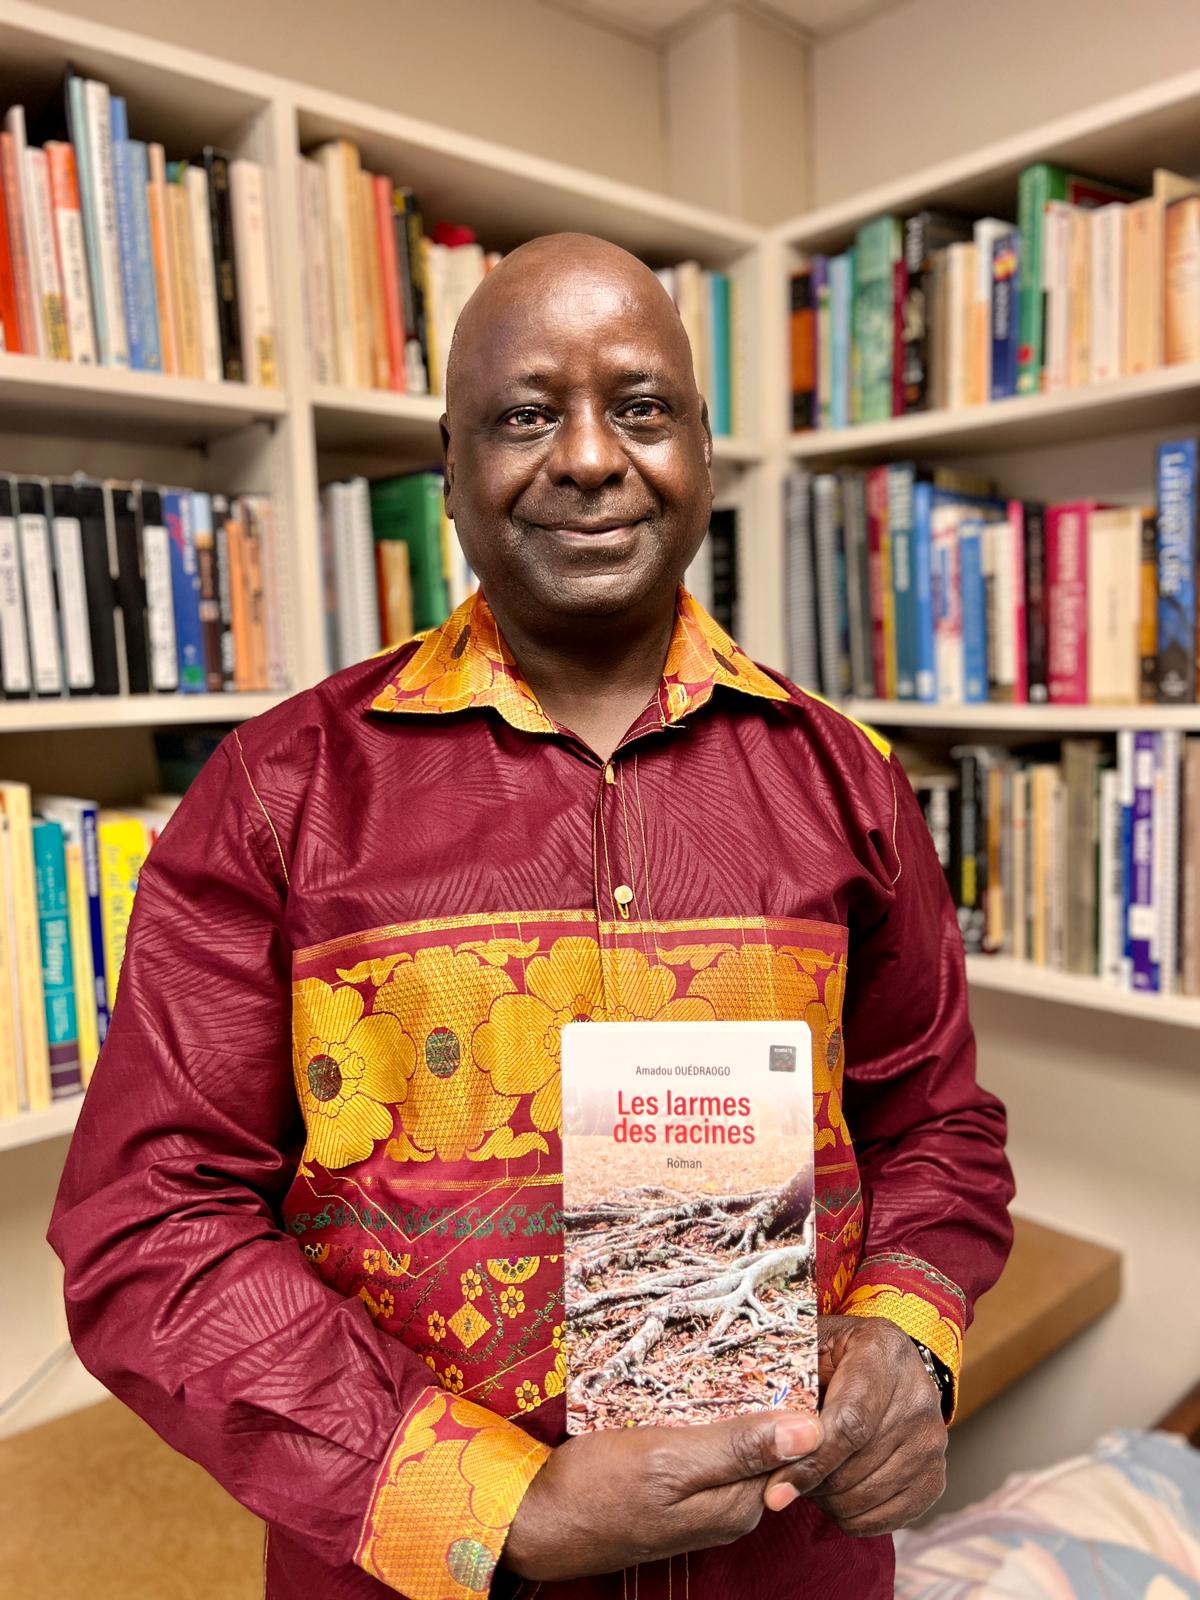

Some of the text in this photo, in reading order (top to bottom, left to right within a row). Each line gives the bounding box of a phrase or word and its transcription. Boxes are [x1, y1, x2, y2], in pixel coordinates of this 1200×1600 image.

[635, 1064, 731, 1076] Amadou OUÉDRAOGO
[618, 1089, 751, 1117] Les larmes
[613, 1117, 756, 1145] des racines
[666, 1157, 702, 1169] Roman
